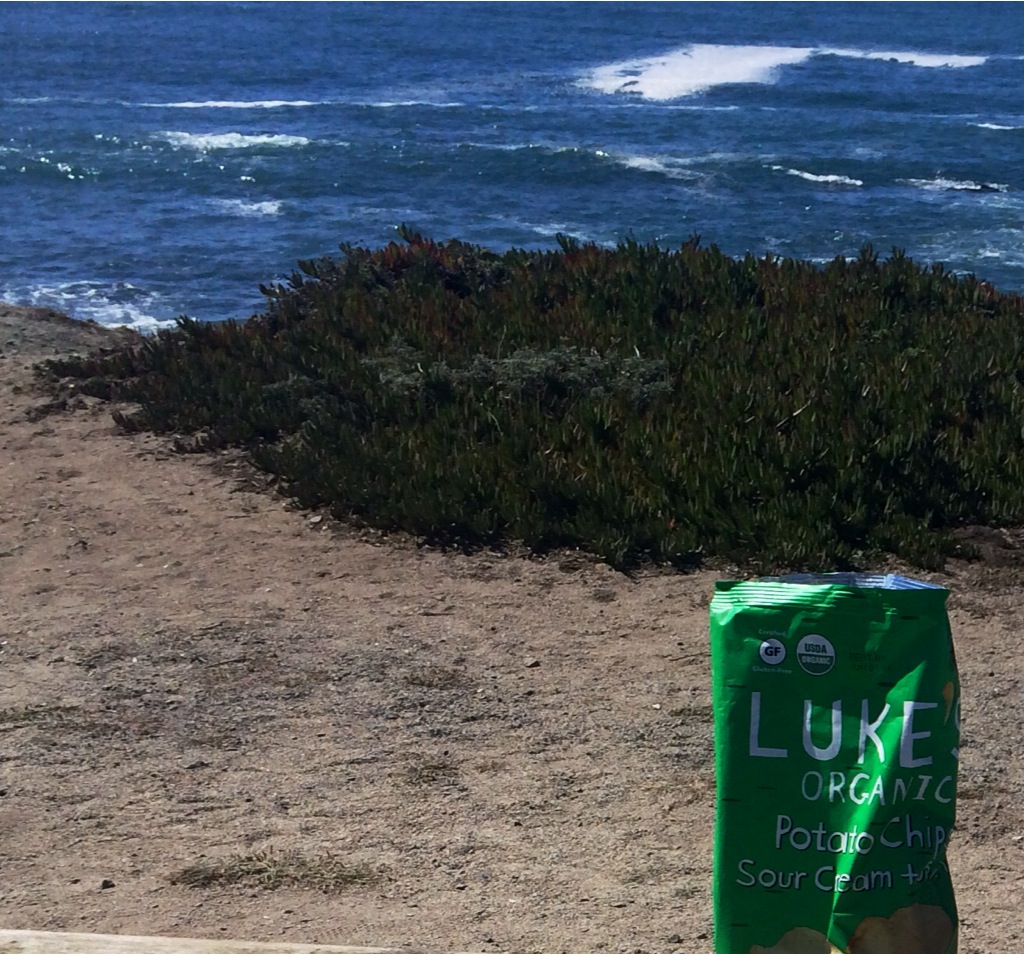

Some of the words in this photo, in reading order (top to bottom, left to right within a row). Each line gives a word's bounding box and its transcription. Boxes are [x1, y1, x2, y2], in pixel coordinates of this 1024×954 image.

[764, 646, 781, 656] GF
[805, 643, 827, 654] USDA
[801, 656, 831, 665] ORGANIC
[801, 771, 951, 806] ORGANIC
[775, 814, 875, 855] Potato
[879, 815, 950, 861] Chip
[736, 859, 808, 889] Sour
[815, 865, 893, 893] Cream
